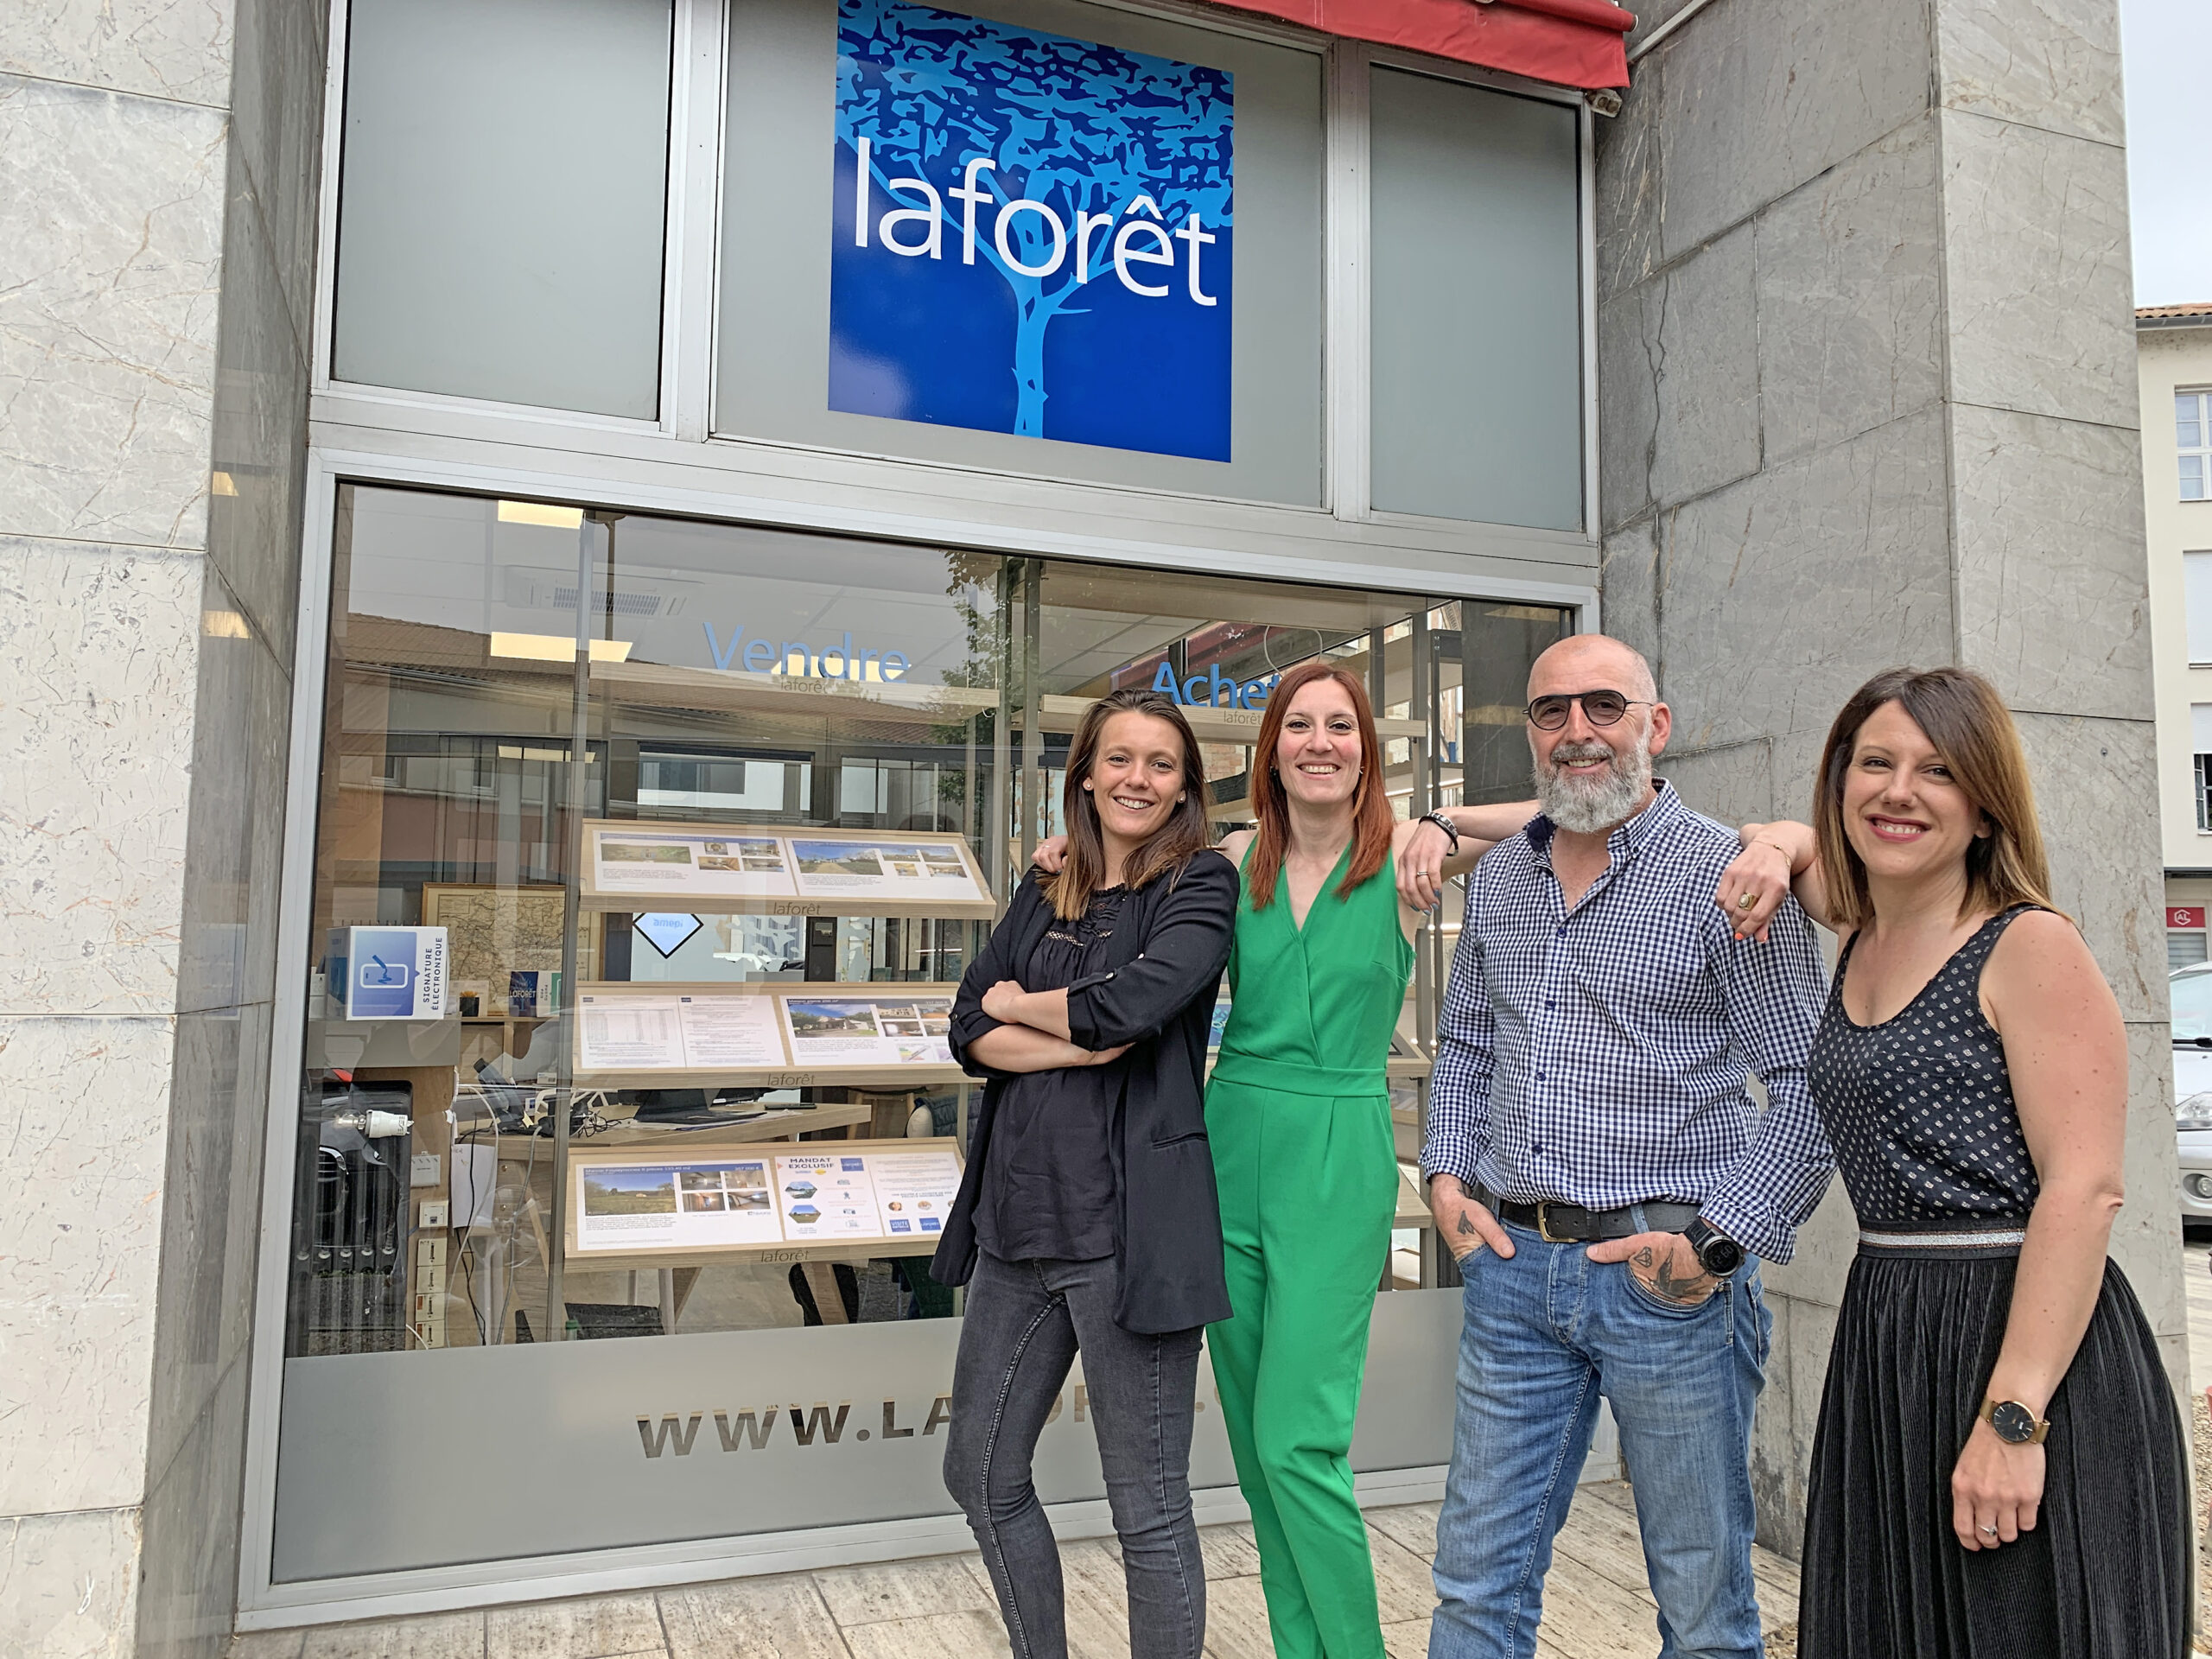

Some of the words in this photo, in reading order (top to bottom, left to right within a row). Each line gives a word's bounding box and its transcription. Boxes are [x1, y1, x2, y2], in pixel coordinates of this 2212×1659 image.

[855, 137, 1217, 307] laforêt
[702, 621, 910, 683] Vendre
[1224, 710, 1262, 726] laforêt
[773, 901, 821, 916] laforêt
[652, 918, 683, 929] amepi
[423, 948, 433, 1003] SIGNATURE
[430, 937, 442, 1010] ÉLECTRONIQUE
[766, 1072, 816, 1087] laforêt
[760, 1249, 810, 1263] laforêt
